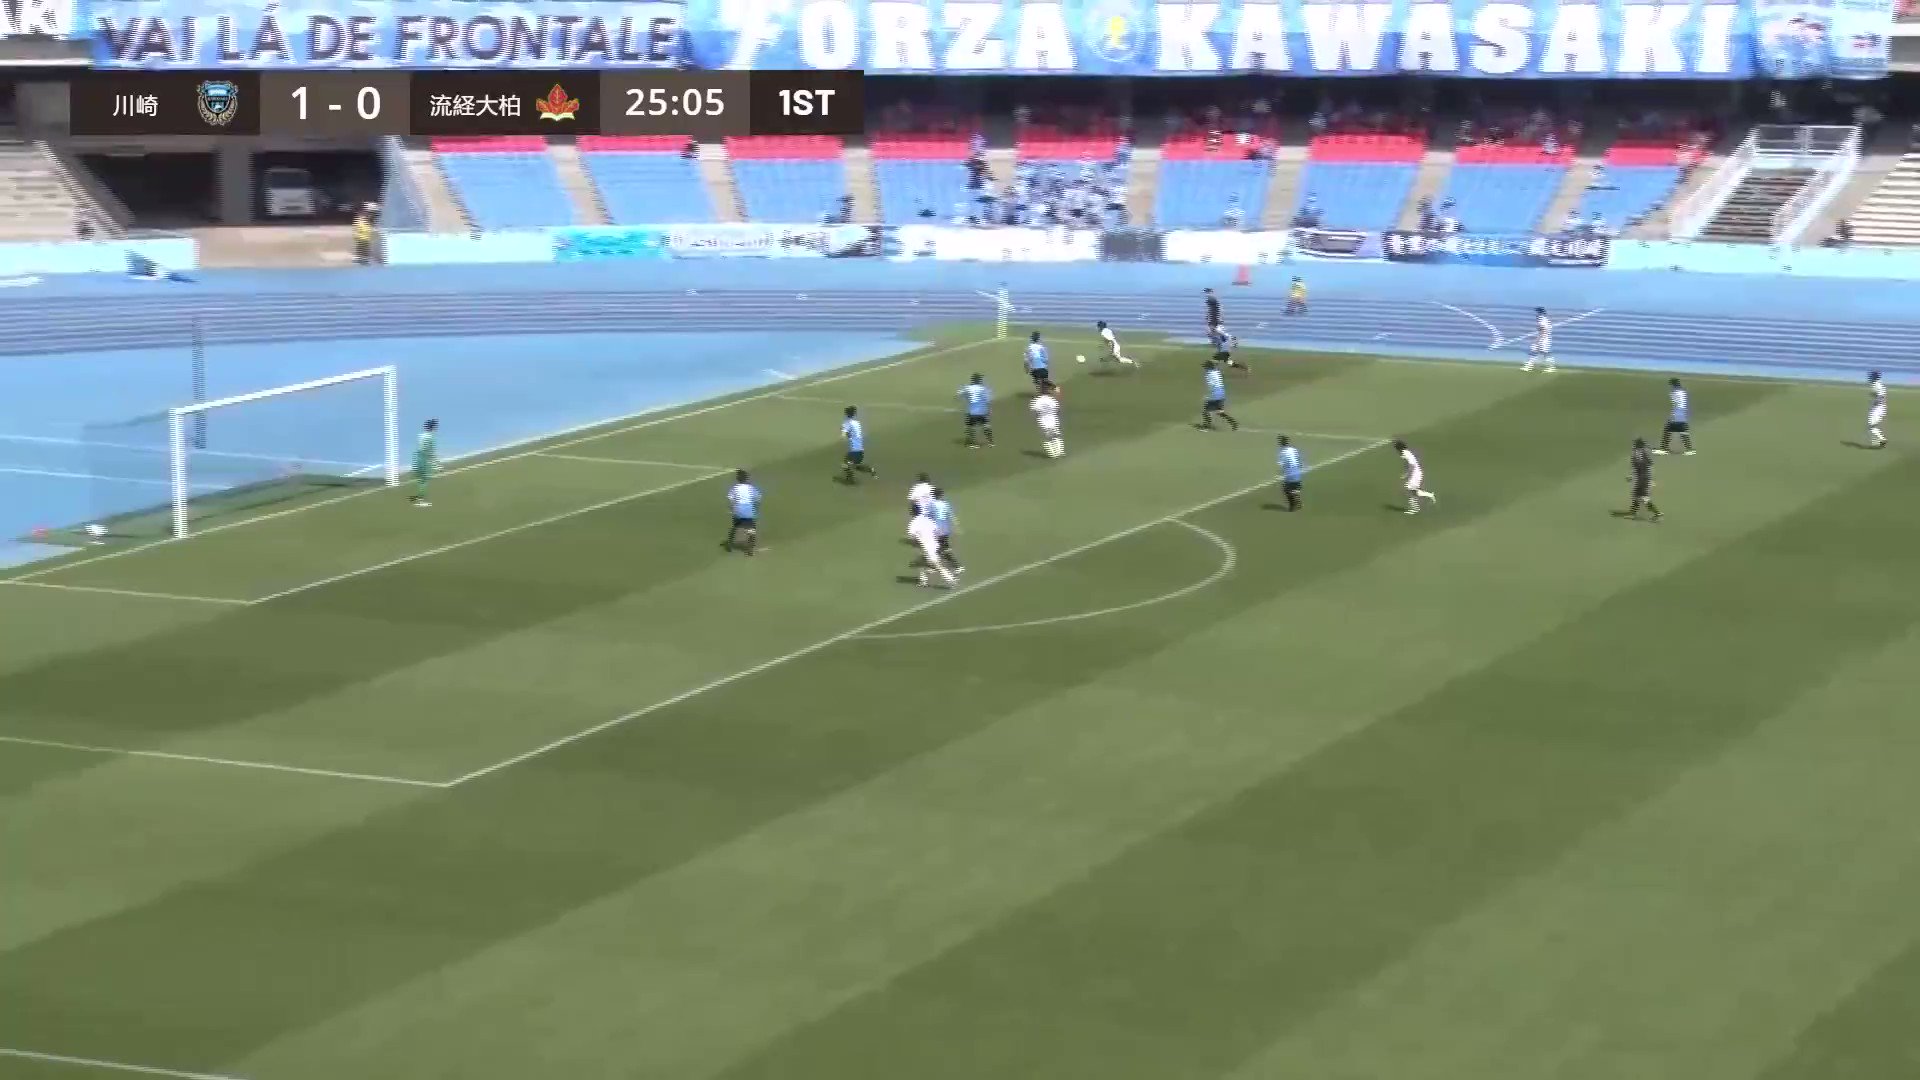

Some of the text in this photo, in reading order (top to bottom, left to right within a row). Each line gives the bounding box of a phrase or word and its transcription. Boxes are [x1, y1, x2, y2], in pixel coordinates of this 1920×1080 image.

[96, 4, 680, 62] VAI LÁ DE FRONTALE
[722, 0, 1735, 74] FORZA KAWASAKI
